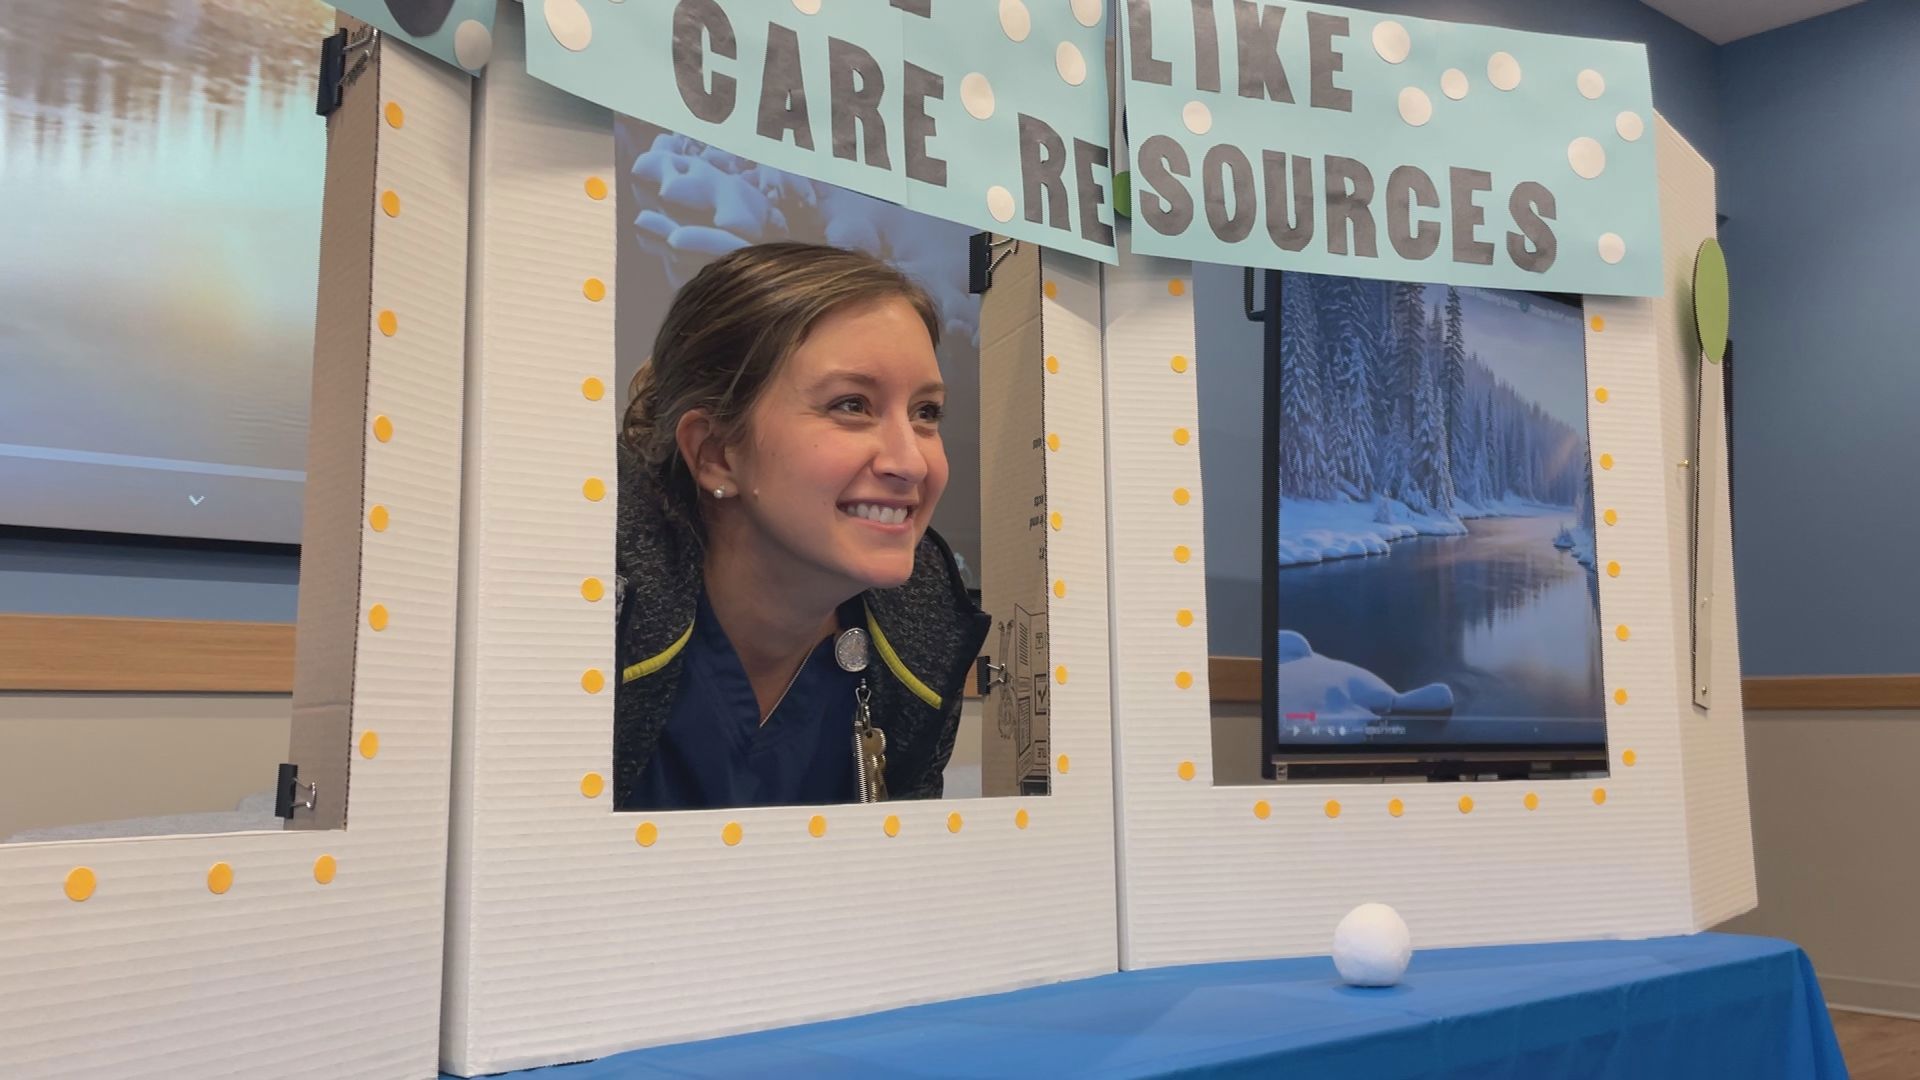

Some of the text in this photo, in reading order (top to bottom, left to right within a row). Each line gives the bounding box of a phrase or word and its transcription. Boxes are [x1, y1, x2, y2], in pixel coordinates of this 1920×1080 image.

[672, 0, 1558, 274] CARE RESOURCES
[1127, 0, 1353, 113] LIKE
